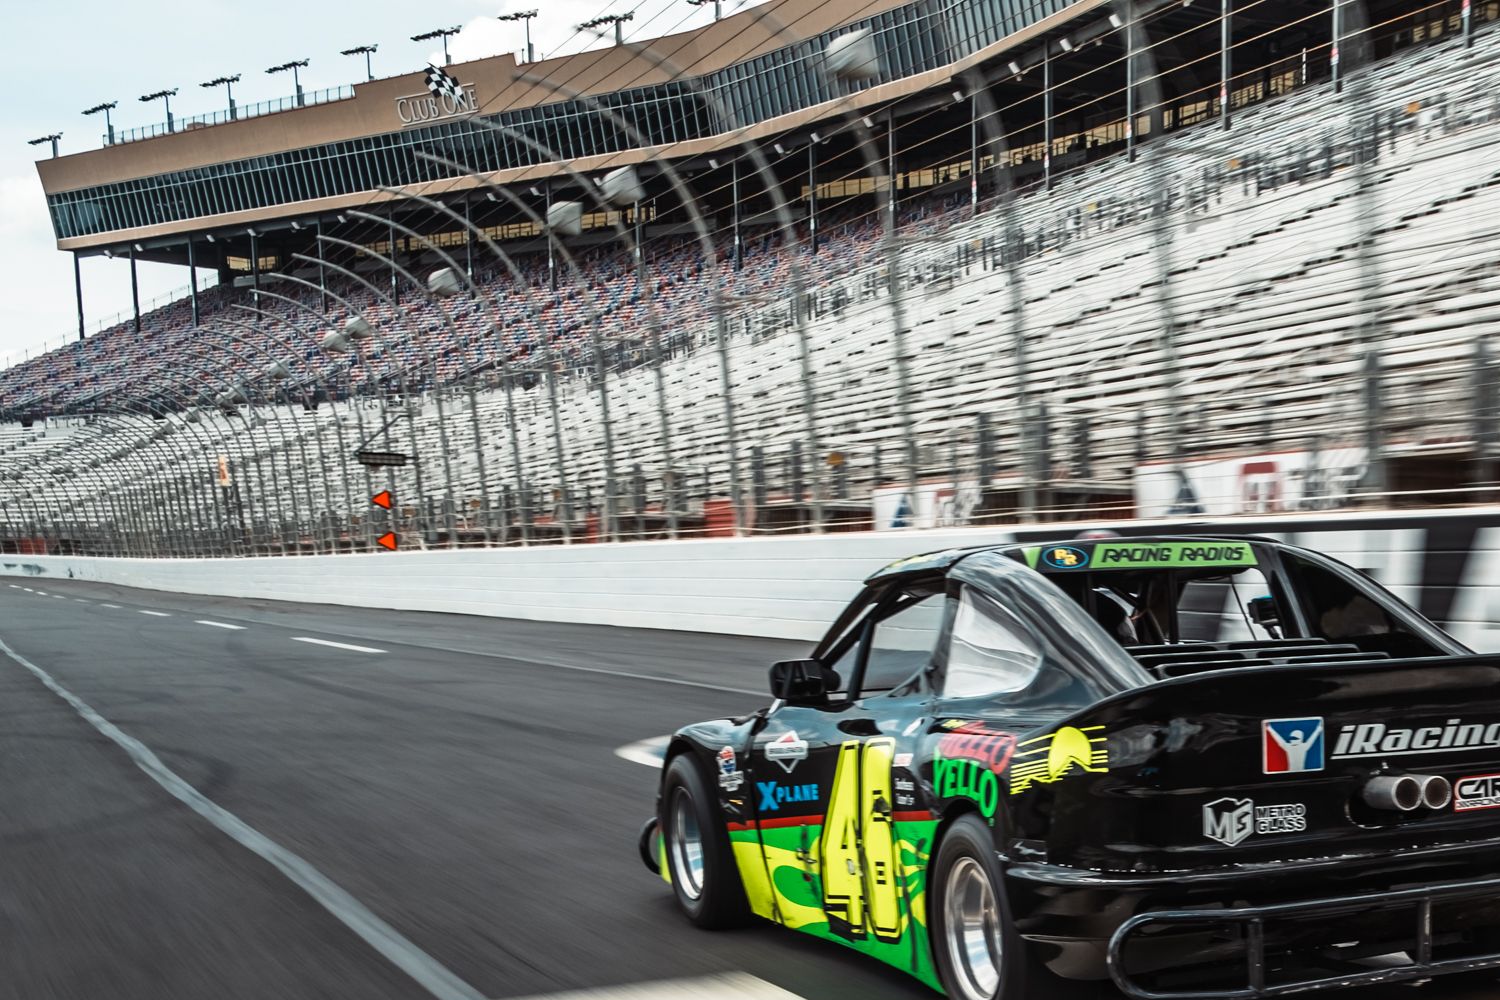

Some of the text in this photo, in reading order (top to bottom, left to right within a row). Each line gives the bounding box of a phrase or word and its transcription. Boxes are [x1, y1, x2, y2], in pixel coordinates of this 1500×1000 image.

[397, 89, 479, 123] CLUB ONE
[1102, 546, 1246, 563] RACING RADIOS
[932, 745, 999, 818] YELLO
[1255, 804, 1307, 820] METRO
[1256, 817, 1307, 834] GLASS
